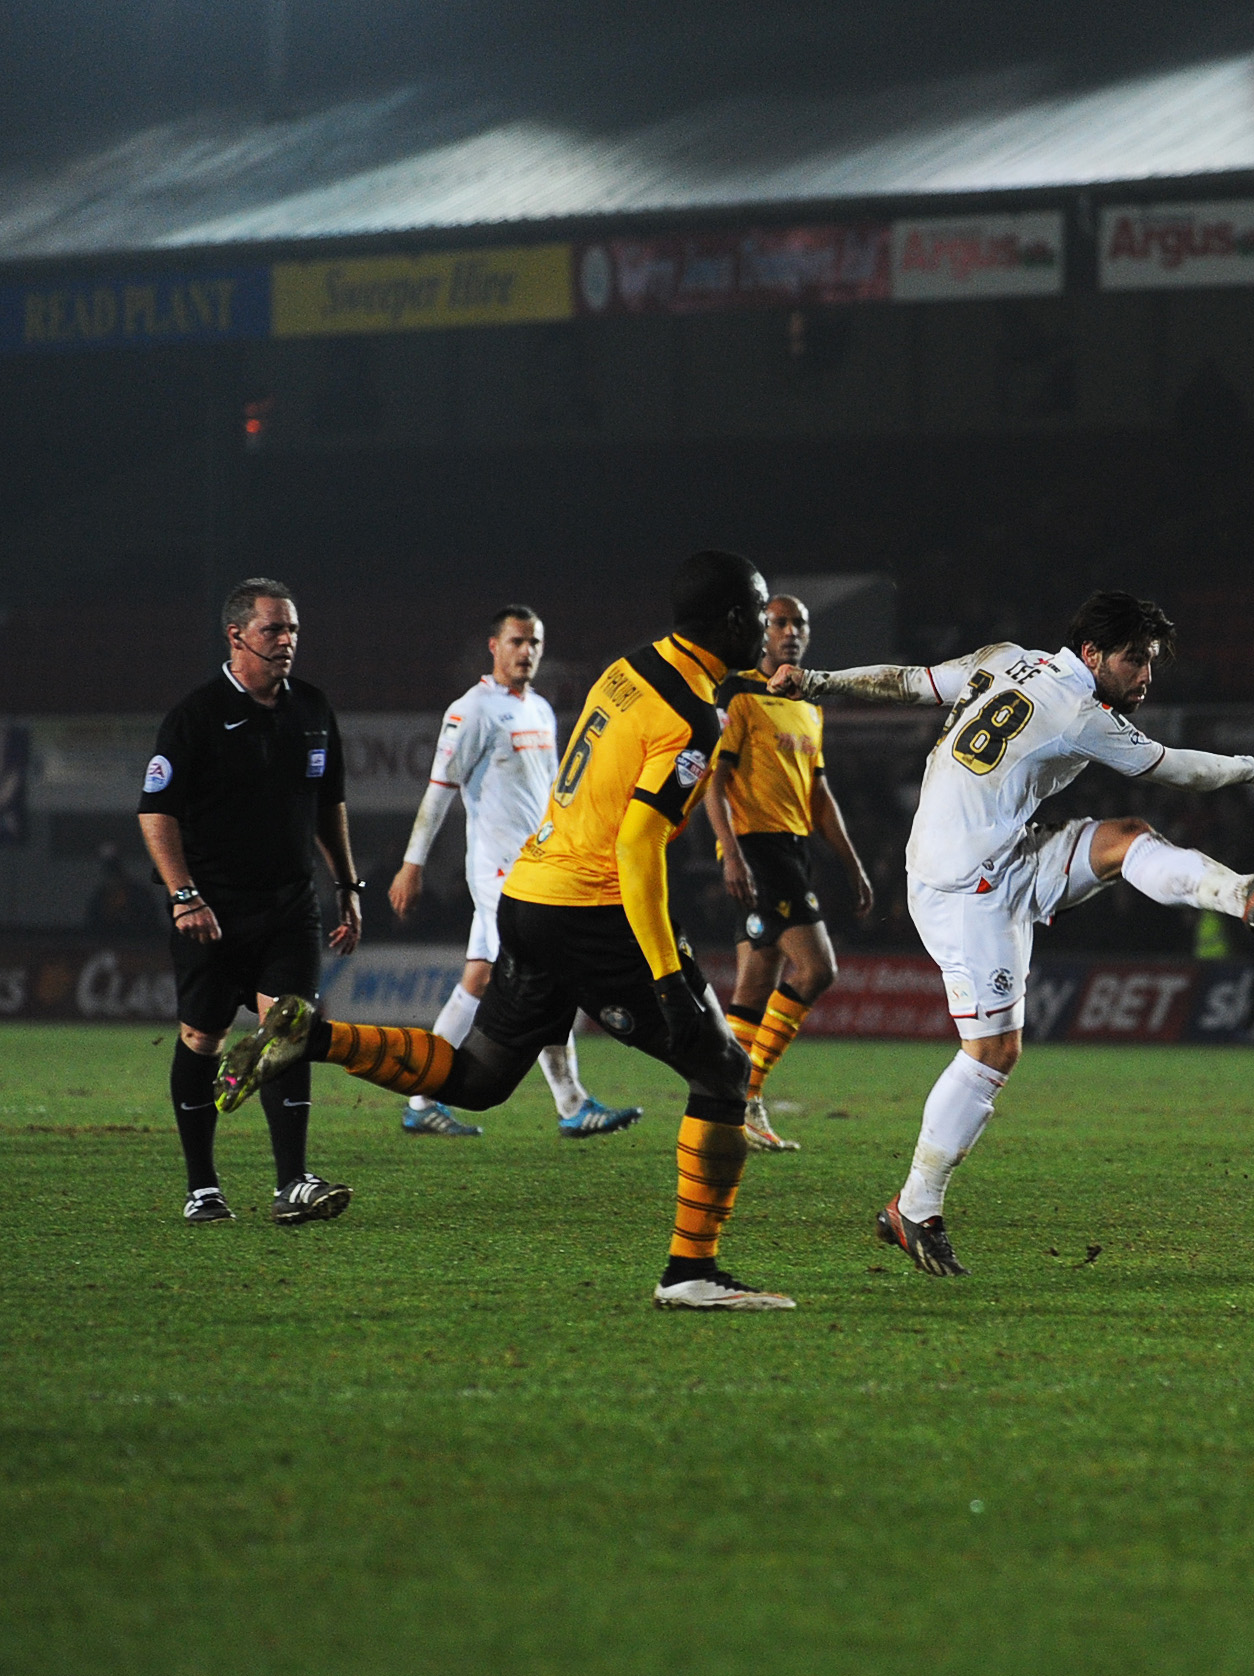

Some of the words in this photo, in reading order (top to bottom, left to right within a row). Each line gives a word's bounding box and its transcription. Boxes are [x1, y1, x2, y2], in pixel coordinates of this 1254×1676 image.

[903, 228, 1022, 279] Argus
[1107, 217, 1236, 268] Argus
[122, 279, 236, 336] PLANT
[1005, 659, 1042, 686] LEE
[554, 706, 610, 808] 6
[1077, 972, 1191, 1032] BET
